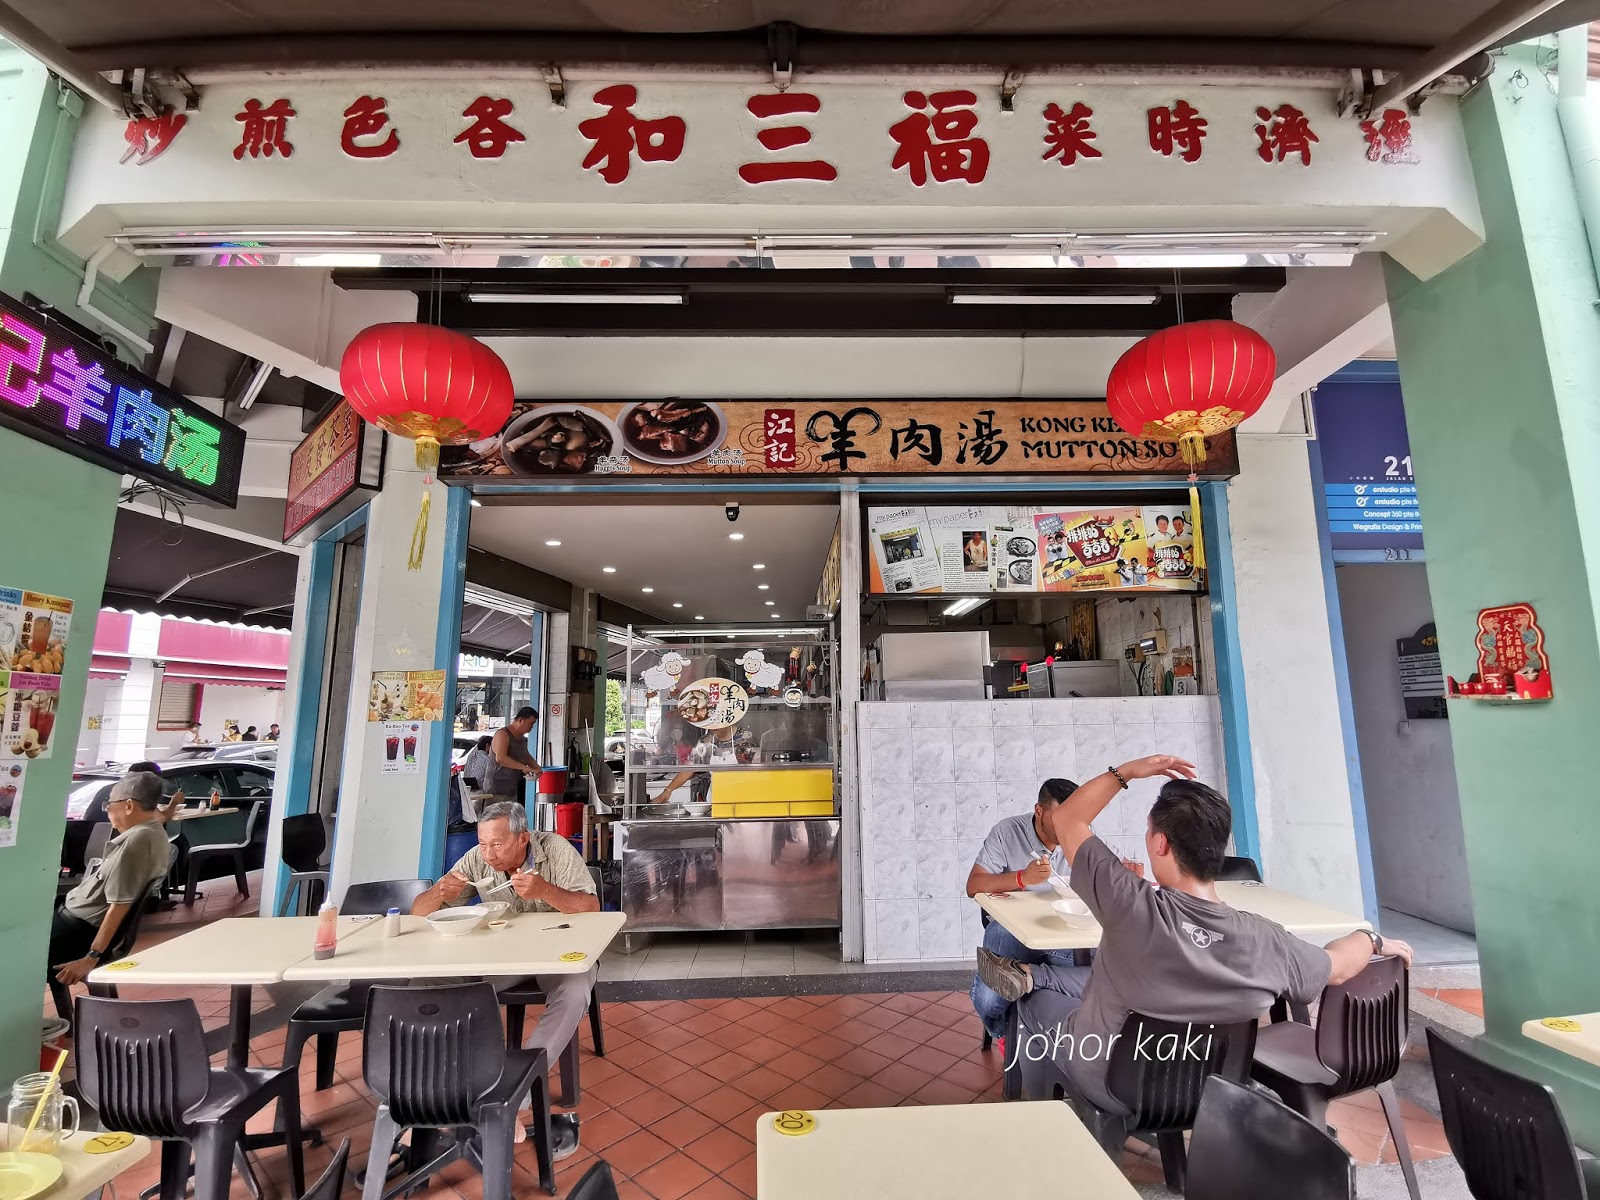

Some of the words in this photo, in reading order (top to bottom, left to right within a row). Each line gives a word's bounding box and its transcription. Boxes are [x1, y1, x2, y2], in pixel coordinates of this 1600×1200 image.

[1020, 417, 1087, 433] KONG
[1021, 440, 1138, 458] MUTTON
[1144, 440, 1212, 458] SOP
[731, 458, 745, 466] Soup
[1385, 548, 1412, 560] 211
